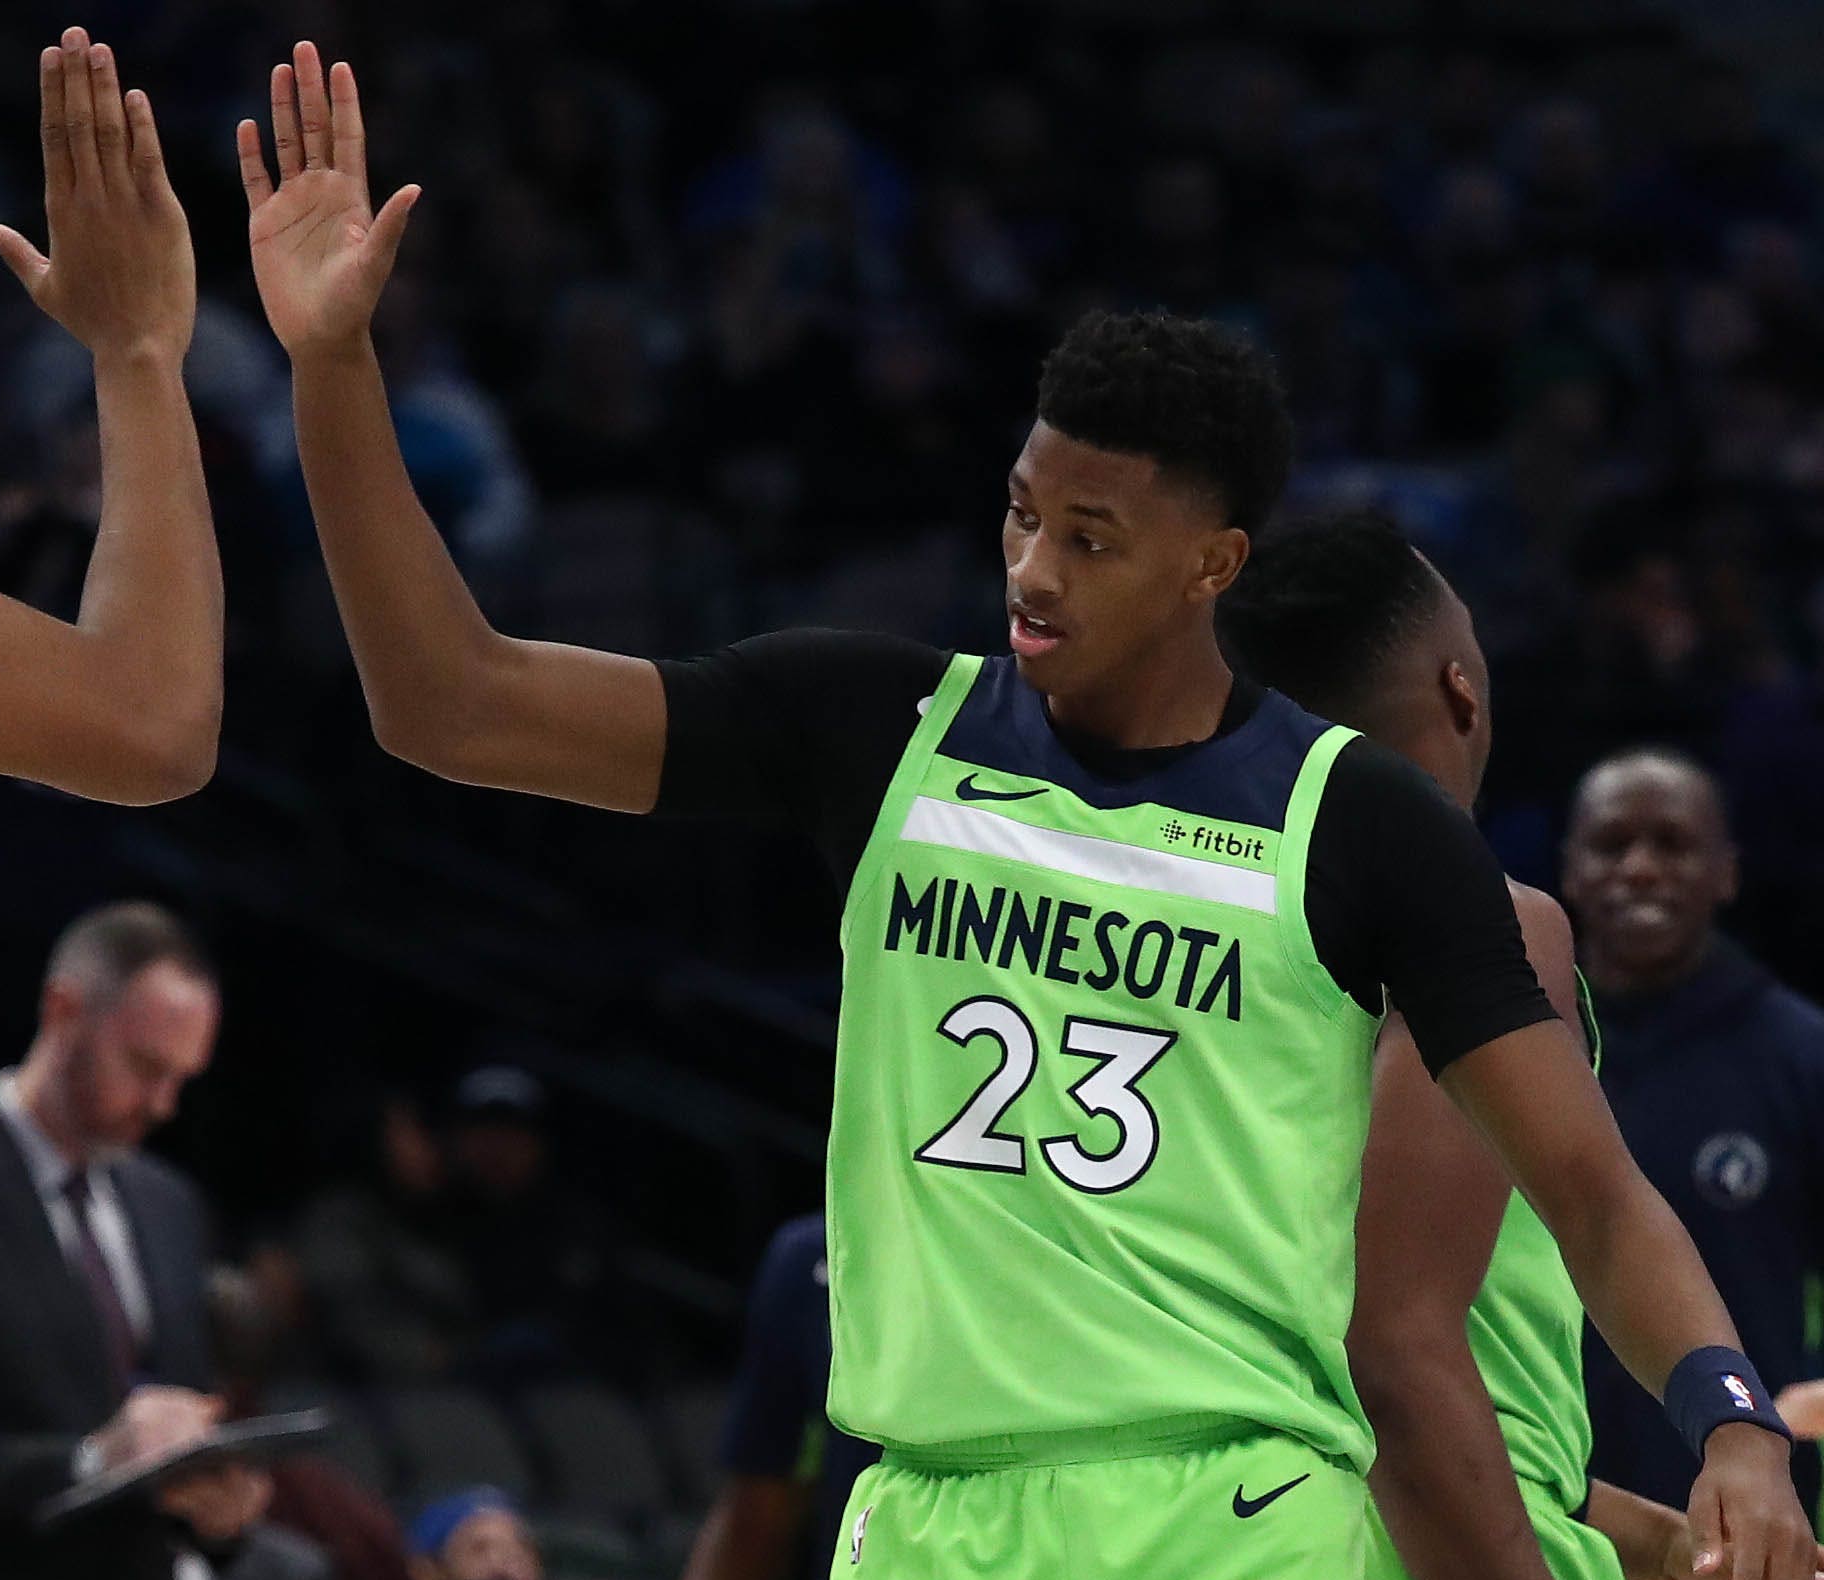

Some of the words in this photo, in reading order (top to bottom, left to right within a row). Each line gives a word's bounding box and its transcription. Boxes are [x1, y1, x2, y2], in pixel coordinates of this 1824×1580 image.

[1192, 827, 1264, 860] fitbit
[884, 871, 1241, 1022] MINNESOTA
[913, 994, 1178, 1195] 23
